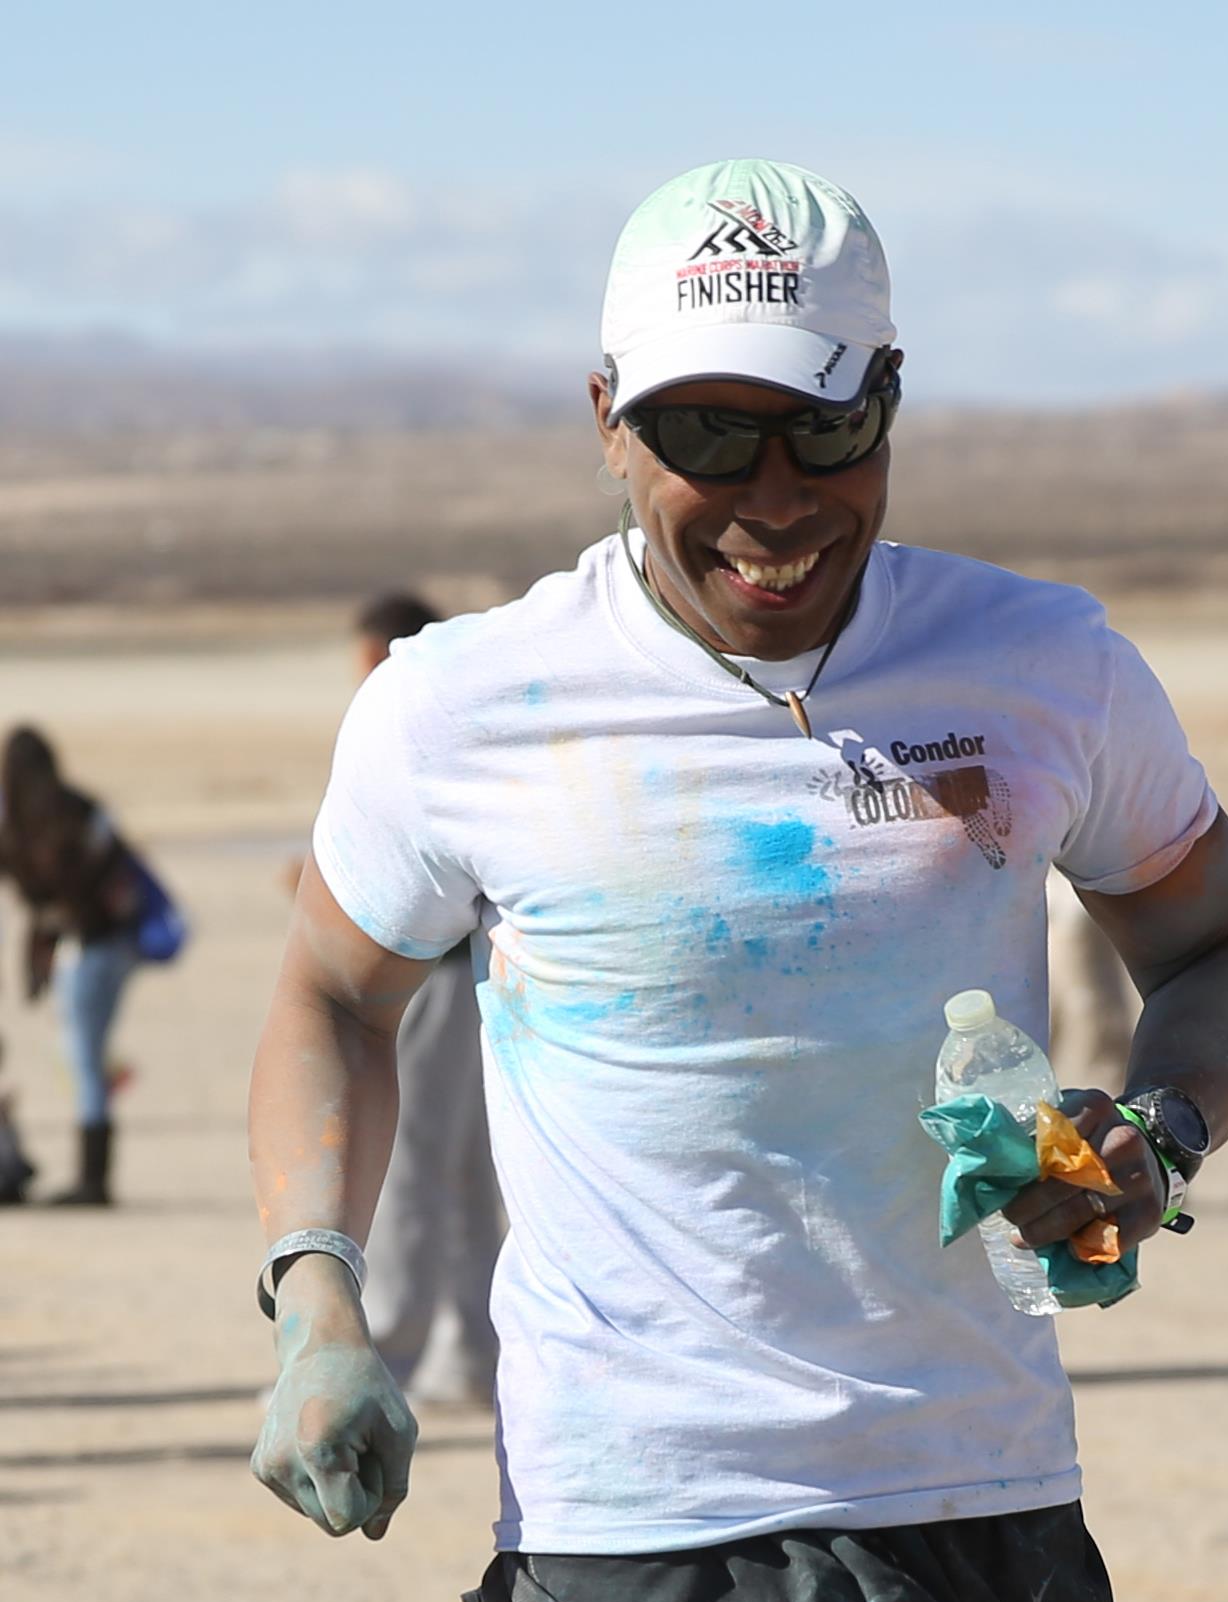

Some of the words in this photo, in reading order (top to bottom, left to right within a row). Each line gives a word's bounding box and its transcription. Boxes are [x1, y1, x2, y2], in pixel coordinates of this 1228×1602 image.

[709, 259, 741, 273] CORPS
[677, 271, 799, 311] FINISHER
[890, 732, 985, 766] Condor
